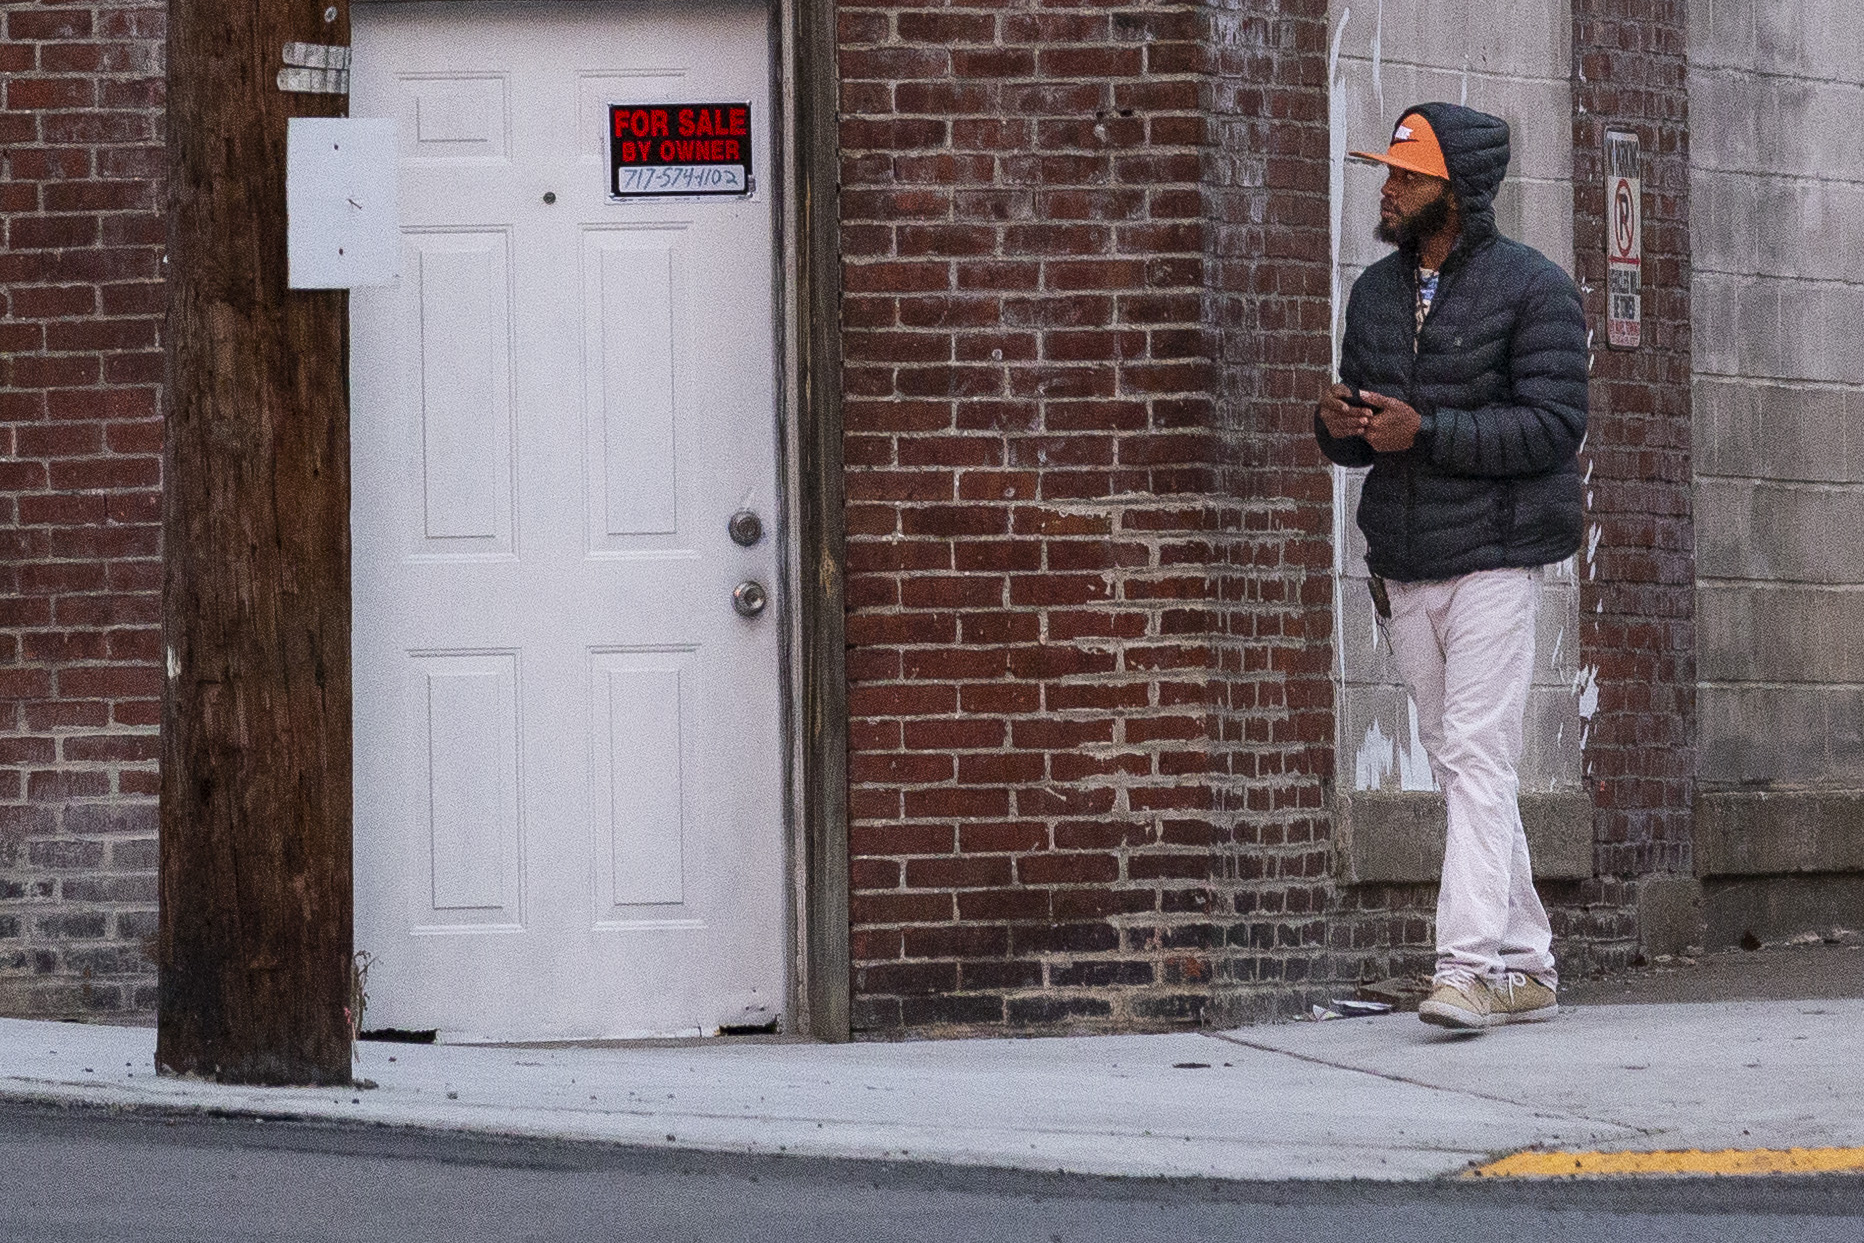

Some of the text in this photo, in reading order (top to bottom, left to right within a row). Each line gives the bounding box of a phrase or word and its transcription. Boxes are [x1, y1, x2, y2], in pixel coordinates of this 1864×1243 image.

[614, 108, 747, 137] FOR SALE
[622, 139, 740, 162] BY OWNER
